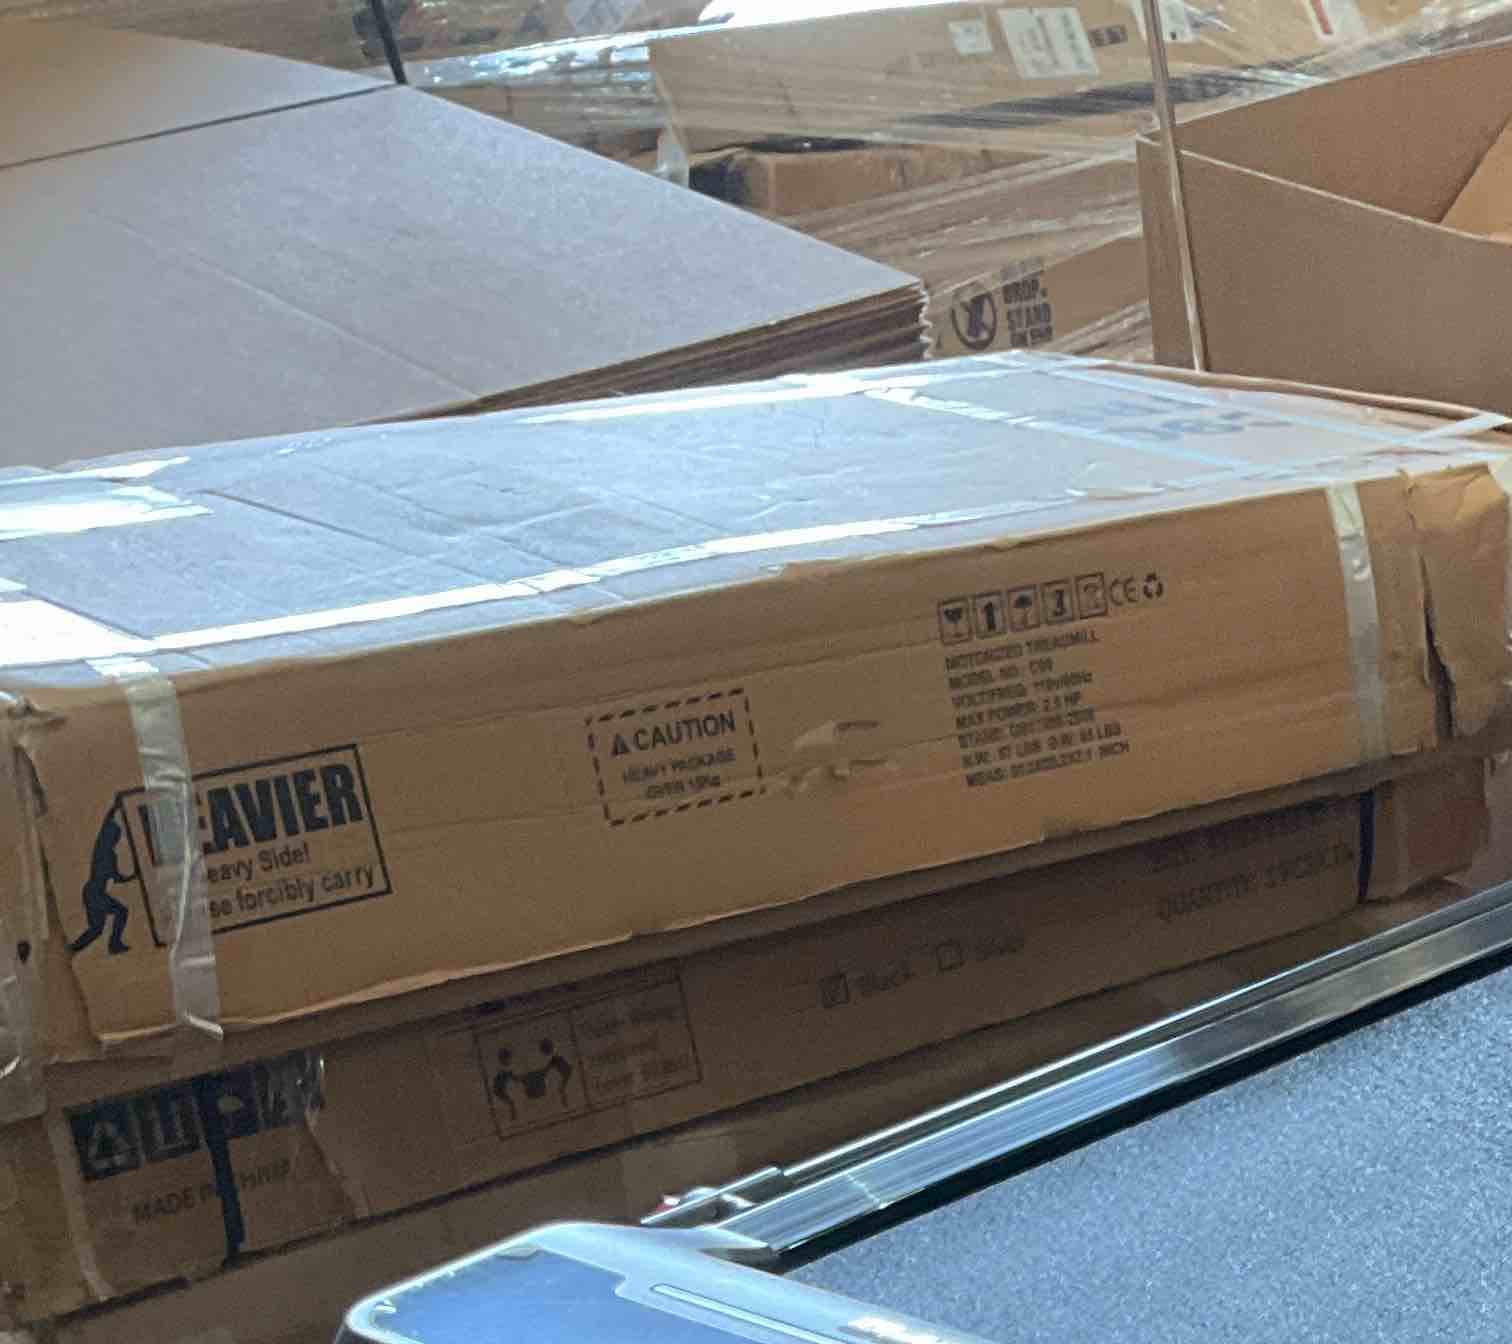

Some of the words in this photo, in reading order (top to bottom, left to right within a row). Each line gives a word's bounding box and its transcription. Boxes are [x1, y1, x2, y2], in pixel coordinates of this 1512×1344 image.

[633, 709, 737, 751] CAUTION
[138, 763, 363, 867] AVIER
[257, 842, 311, 872] Side!
[236, 876, 316, 911] forcibly
[321, 862, 375, 893] carry
